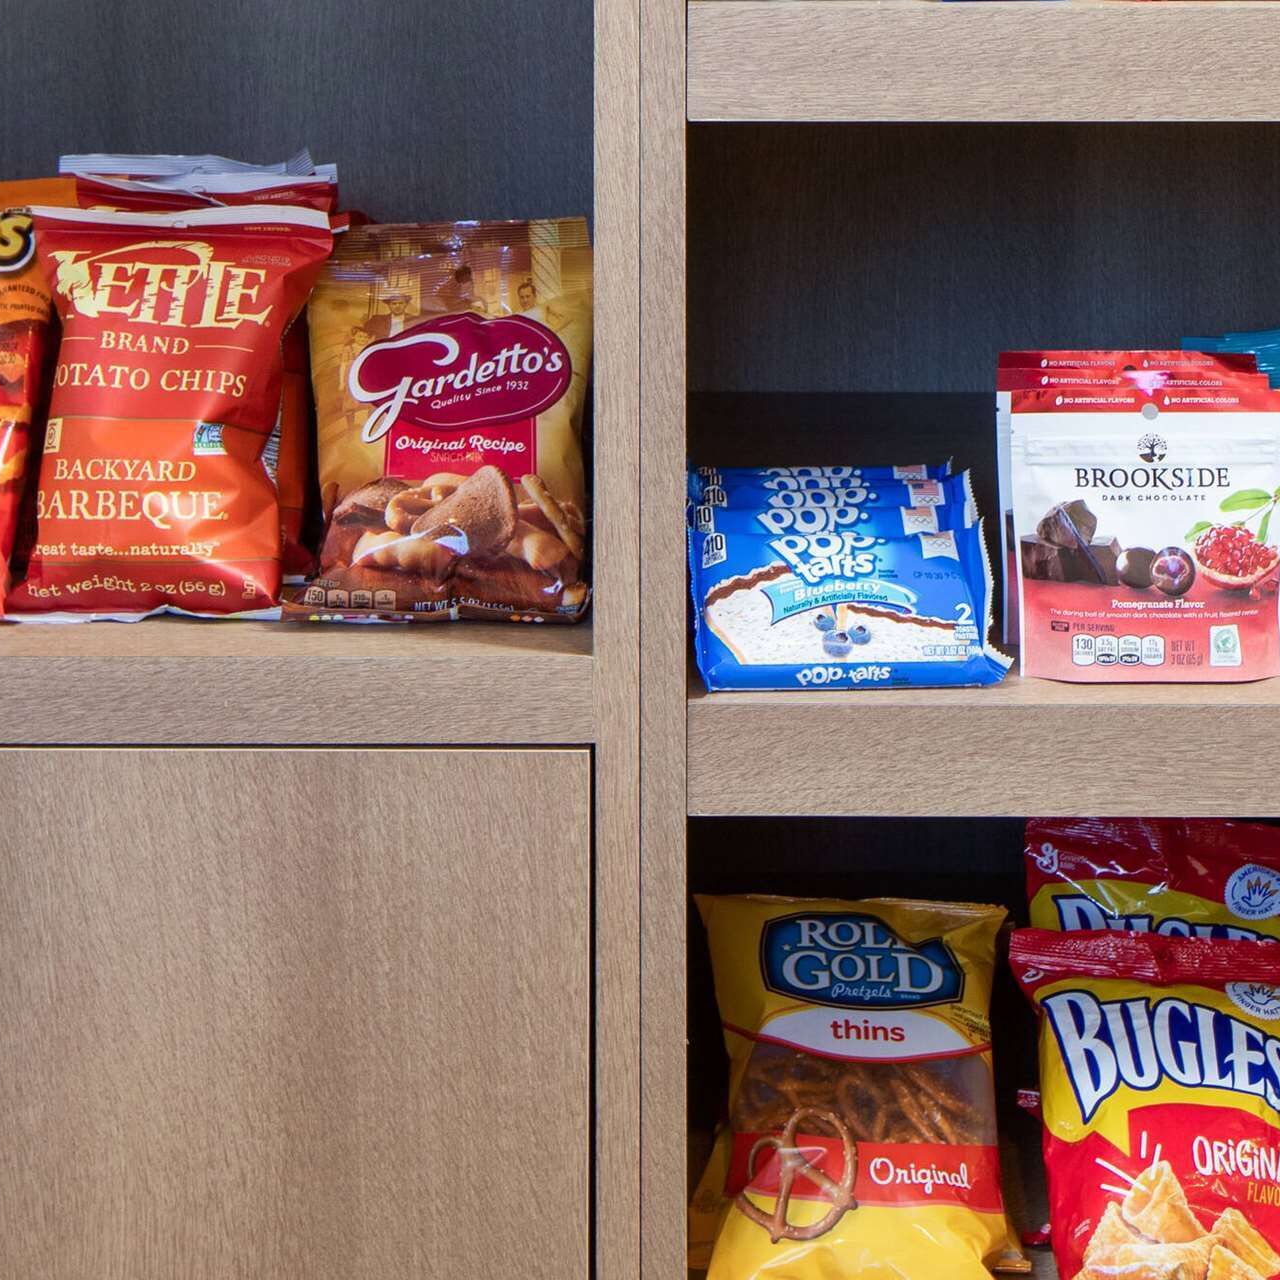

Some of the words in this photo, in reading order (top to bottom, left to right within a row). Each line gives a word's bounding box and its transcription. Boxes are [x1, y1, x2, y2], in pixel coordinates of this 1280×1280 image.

[100, 331, 190, 355] BRAND
[160, 369, 248, 398] CHIPS
[350, 333, 565, 444] Gardetto's
[431, 393, 472, 410] Quality
[476, 384, 503, 400] Since
[505, 380, 530, 392] 1932
[395, 435, 466, 462] Original
[469, 435, 528, 454] Recipe
[54, 458, 196, 482] BACKYARD
[1074, 467, 1231, 491] BROOKSIDE
[1101, 494, 1133, 502] DARK
[1137, 494, 1207, 502] CHOCOLATE
[704, 534, 724, 556] 410
[28, 583, 63, 599] net
[67, 574, 137, 593] weight
[140, 582, 152, 592] 2
[156, 584, 177, 595] oz
[794, 579, 880, 601] Blueberry
[414, 601, 432, 612] NET
[783, 597, 813, 615] Naturally
[821, 592, 856, 603] Artificially
[857, 592, 888, 602] Flavored
[955, 603, 972, 624] 2
[1111, 599, 1174, 611] Pomegranate
[1174, 599, 1206, 610] Flavor
[1075, 638, 1093, 651] 130
[782, 950, 946, 996] GOLD
[832, 984, 893, 1000] Pretzels
[1235, 993, 1261, 1013] FINGER
[830, 1018, 907, 1043] thins
[869, 1157, 972, 1195] Original
